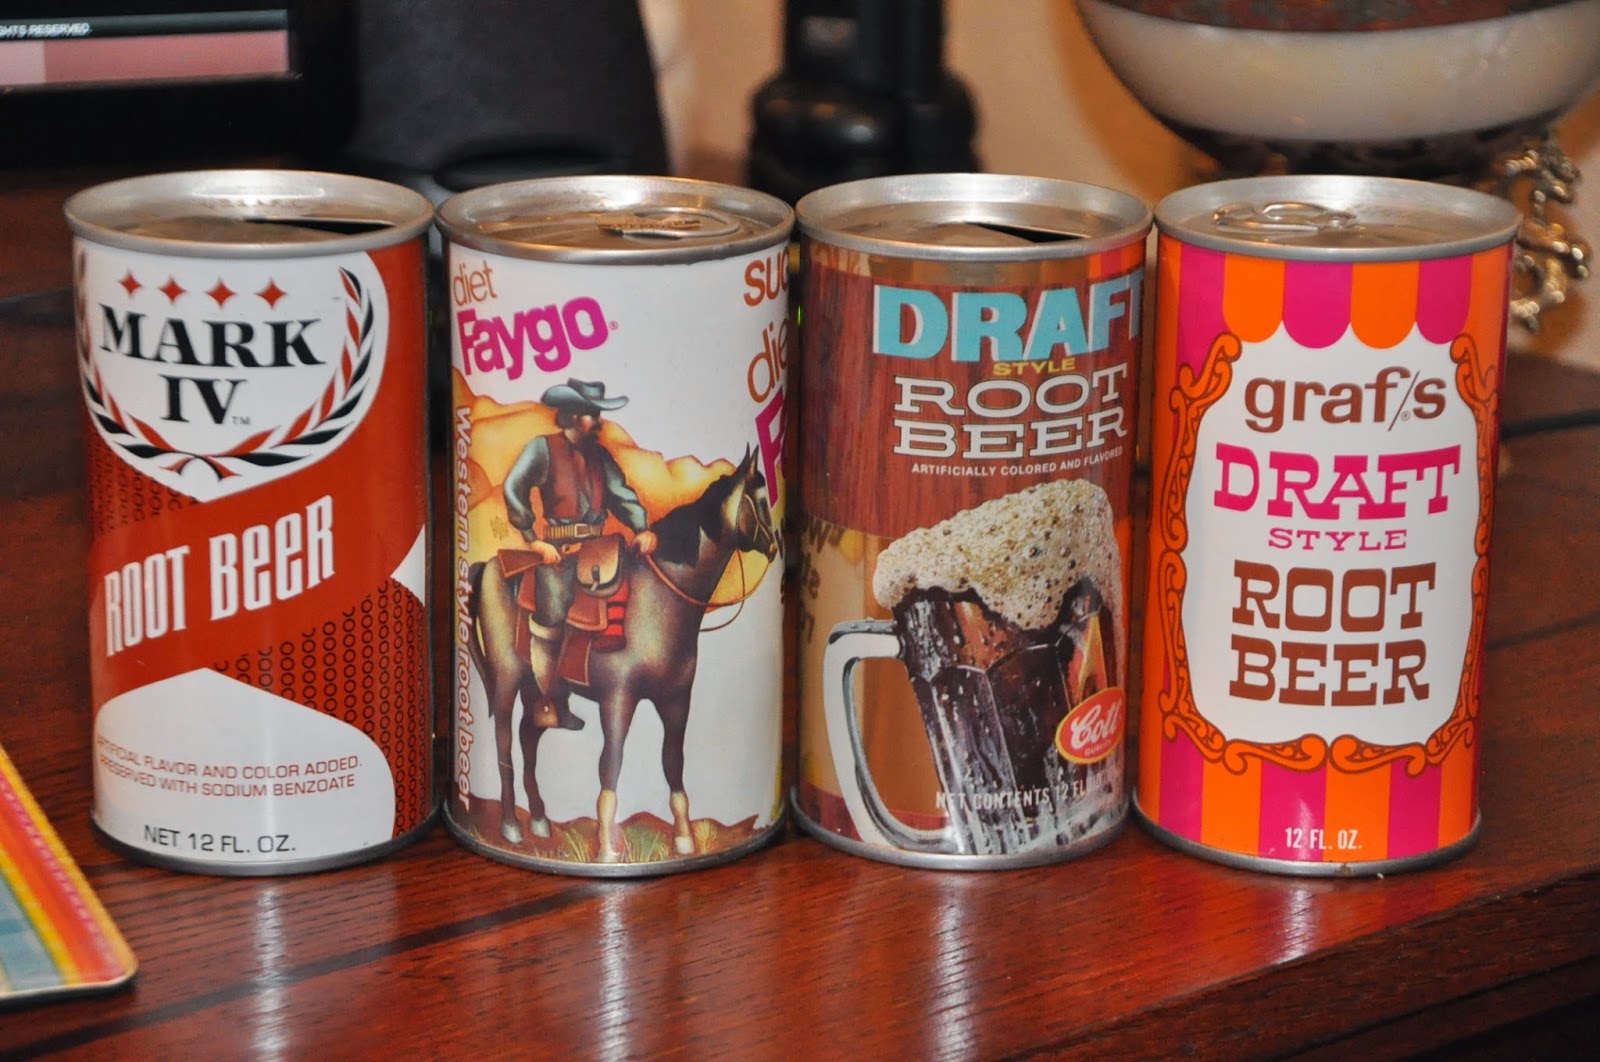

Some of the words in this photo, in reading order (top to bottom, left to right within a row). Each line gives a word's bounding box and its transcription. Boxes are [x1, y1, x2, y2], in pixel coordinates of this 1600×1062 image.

[453, 260, 498, 307] diet
[98, 302, 327, 369] MARK
[456, 296, 609, 381] Faygo
[894, 362, 1128, 419] ROOT
[992, 357, 1077, 377] STYLE
[158, 373, 248, 426] IV
[893, 406, 1128, 460] BEER
[455, 406, 473, 554] Western
[911, 462, 997, 477] ARTIFICIALLY
[1000, 462, 1057, 476] COLORED
[1059, 458, 1081, 471] AND
[1083, 445, 1124, 468] FLAVORED
[1213, 442, 1462, 521] DRAFT
[1267, 527, 1408, 552] STYLE
[104, 545, 190, 657] ROOT
[456, 555, 474, 646] style
[1231, 559, 1437, 632] ROOT
[458, 648, 474, 726] root
[1228, 633, 1430, 707] BEER
[143, 754, 198, 777] FLAVOR
[202, 765, 238, 780] AND
[241, 763, 300, 780] COLOR
[304, 754, 363, 777] ADDED.
[158, 776, 198, 795] WITH
[201, 782, 268, 798] SODIUM
[272, 773, 356, 797] BENZOATE
[458, 726, 474, 813] beer
[935, 790, 967, 810] NET
[973, 786, 1052, 810] CONTENTS
[1055, 780, 1069, 801] 12
[144, 823, 181, 848] NET
[187, 832, 215, 852] 12
[220, 835, 251, 854] FL.
[256, 834, 296, 854] OZ.
[1284, 826, 1303, 849] 12
[1309, 828, 1333, 850] FL.
[1337, 828, 1363, 850] OZ.
